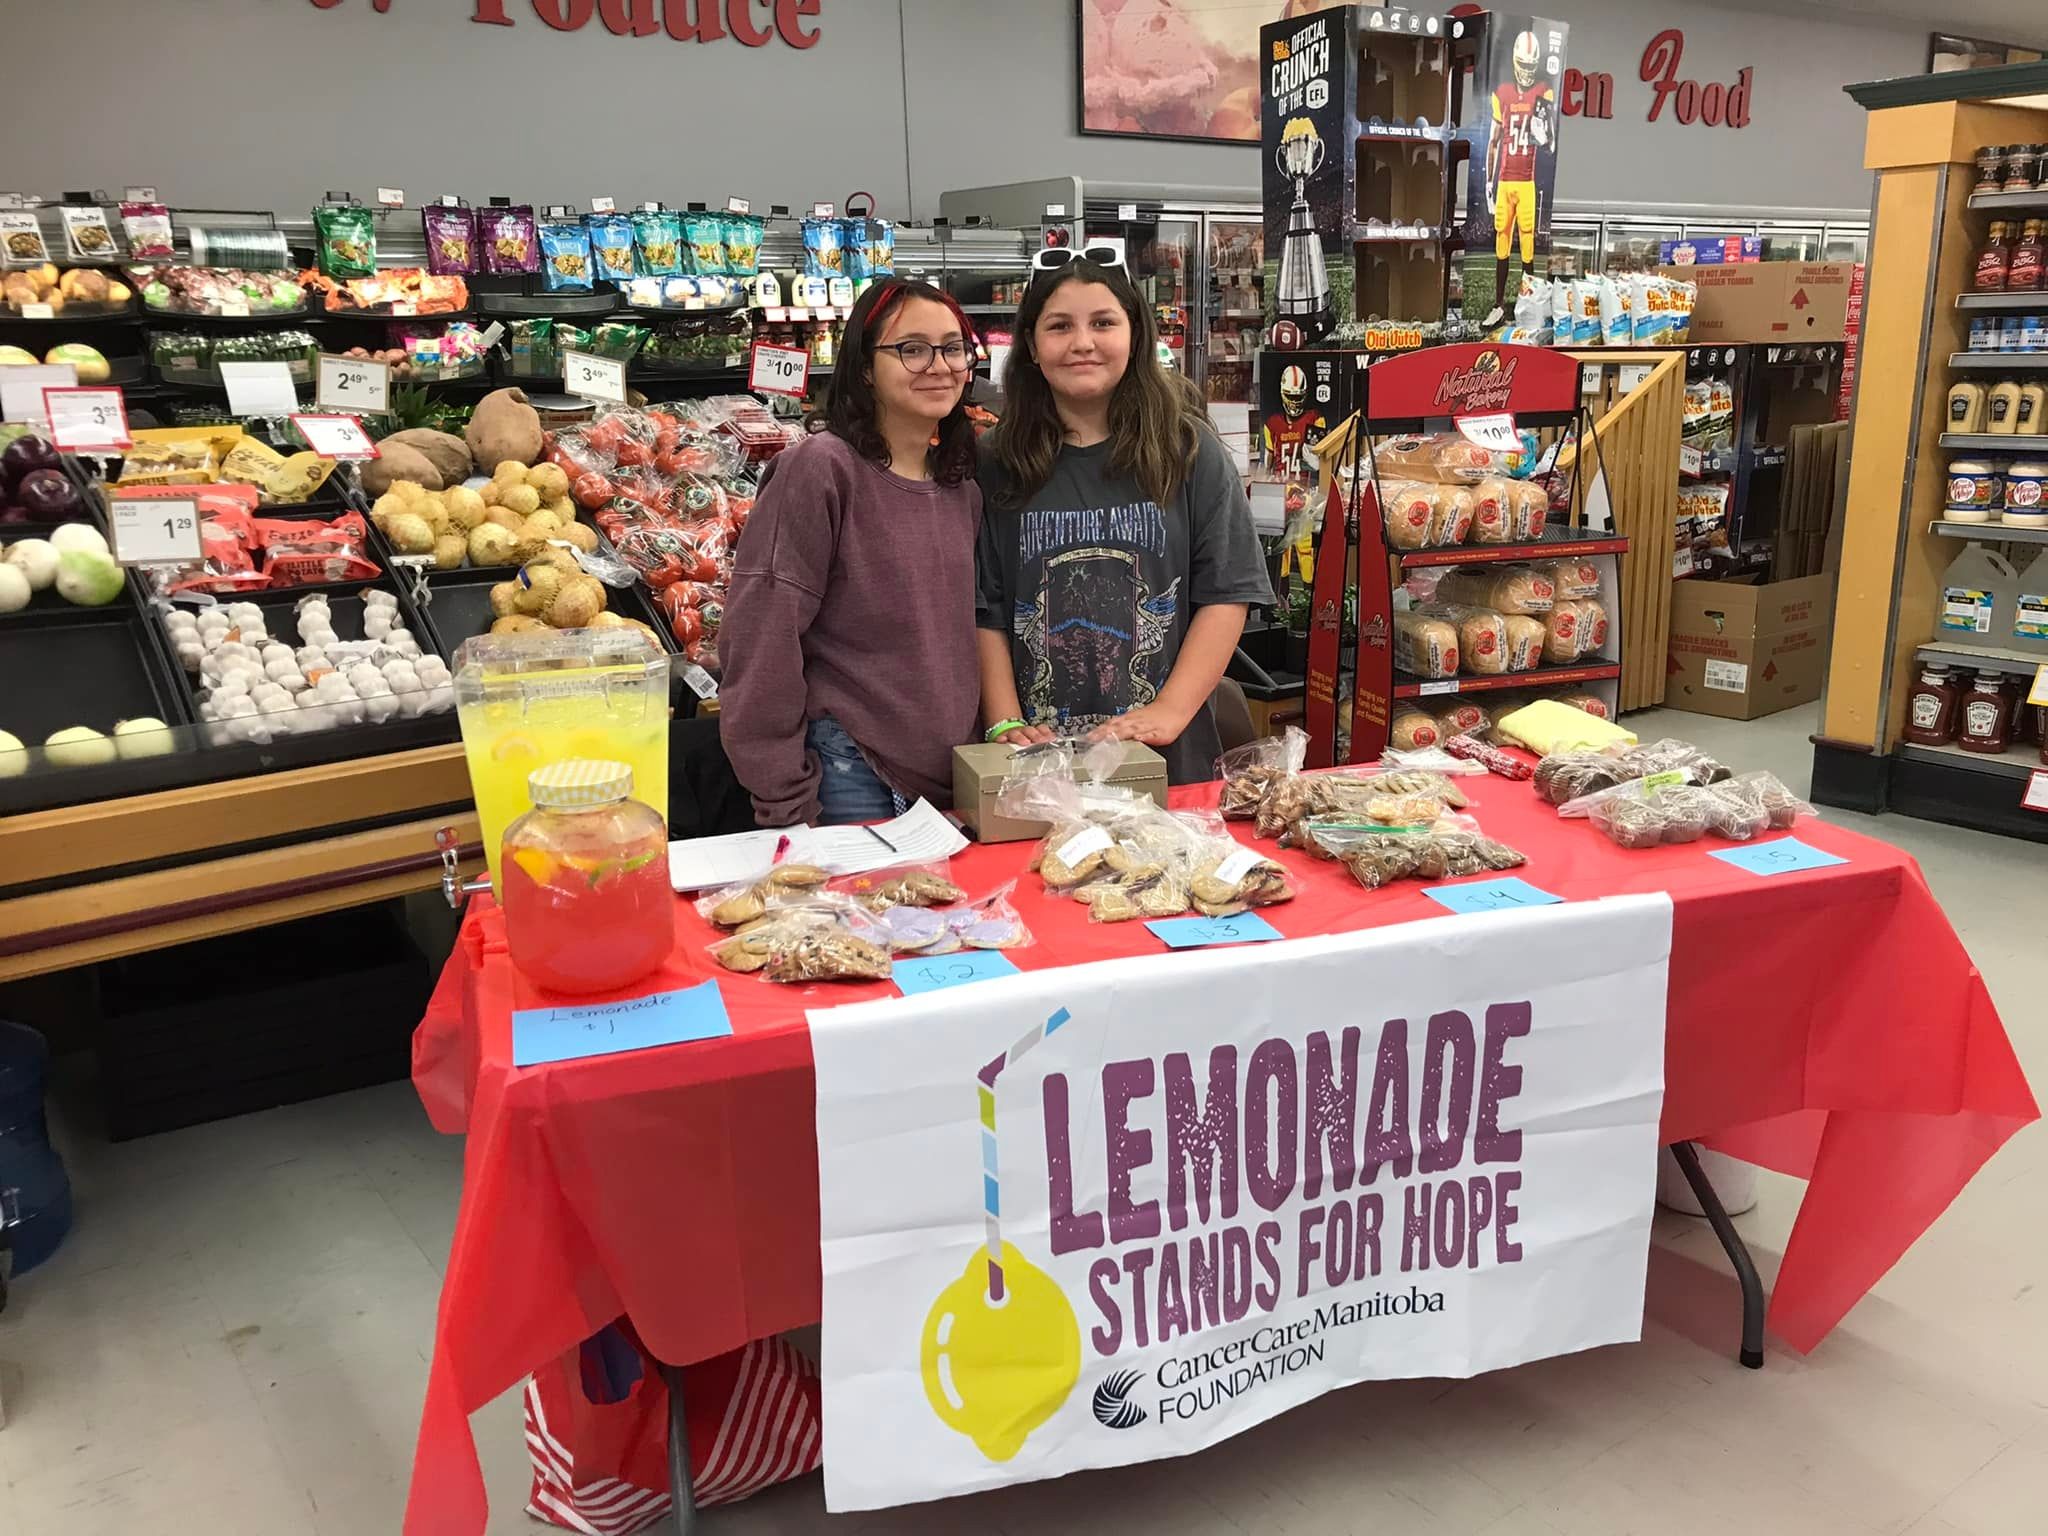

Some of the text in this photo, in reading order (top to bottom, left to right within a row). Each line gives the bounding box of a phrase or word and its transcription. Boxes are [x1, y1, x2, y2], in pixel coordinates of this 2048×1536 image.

[1291, 18, 1327, 54] OFFICIAL
[1272, 38, 1330, 98] CRUNCH
[1639, 29, 1754, 128] Food
[1278, 87, 1326, 117] OF THE CFL
[1508, 114, 1529, 155] 54
[1978, 256, 2001, 270] BBQ
[2012, 255, 2036, 268] BBQ
[1366, 328, 1422, 350] Old Dutch
[1433, 357, 1518, 406] Natural
[1465, 388, 1511, 412] Bakery
[1711, 400, 1732, 412] utch
[1280, 442, 1301, 479] 54
[1019, 501, 1167, 566] ADVENTURE AWAITS
[1465, 890, 1526, 907] $4
[1189, 923, 1240, 940] $3
[917, 963, 984, 985] $2
[549, 995, 673, 1023] Lemonade
[1043, 1001, 1532, 1256] LEMONADE
[1088, 1170, 1522, 1356] STANDS FOR HOPE
[1158, 1338, 1326, 1424] FOUNDATION
